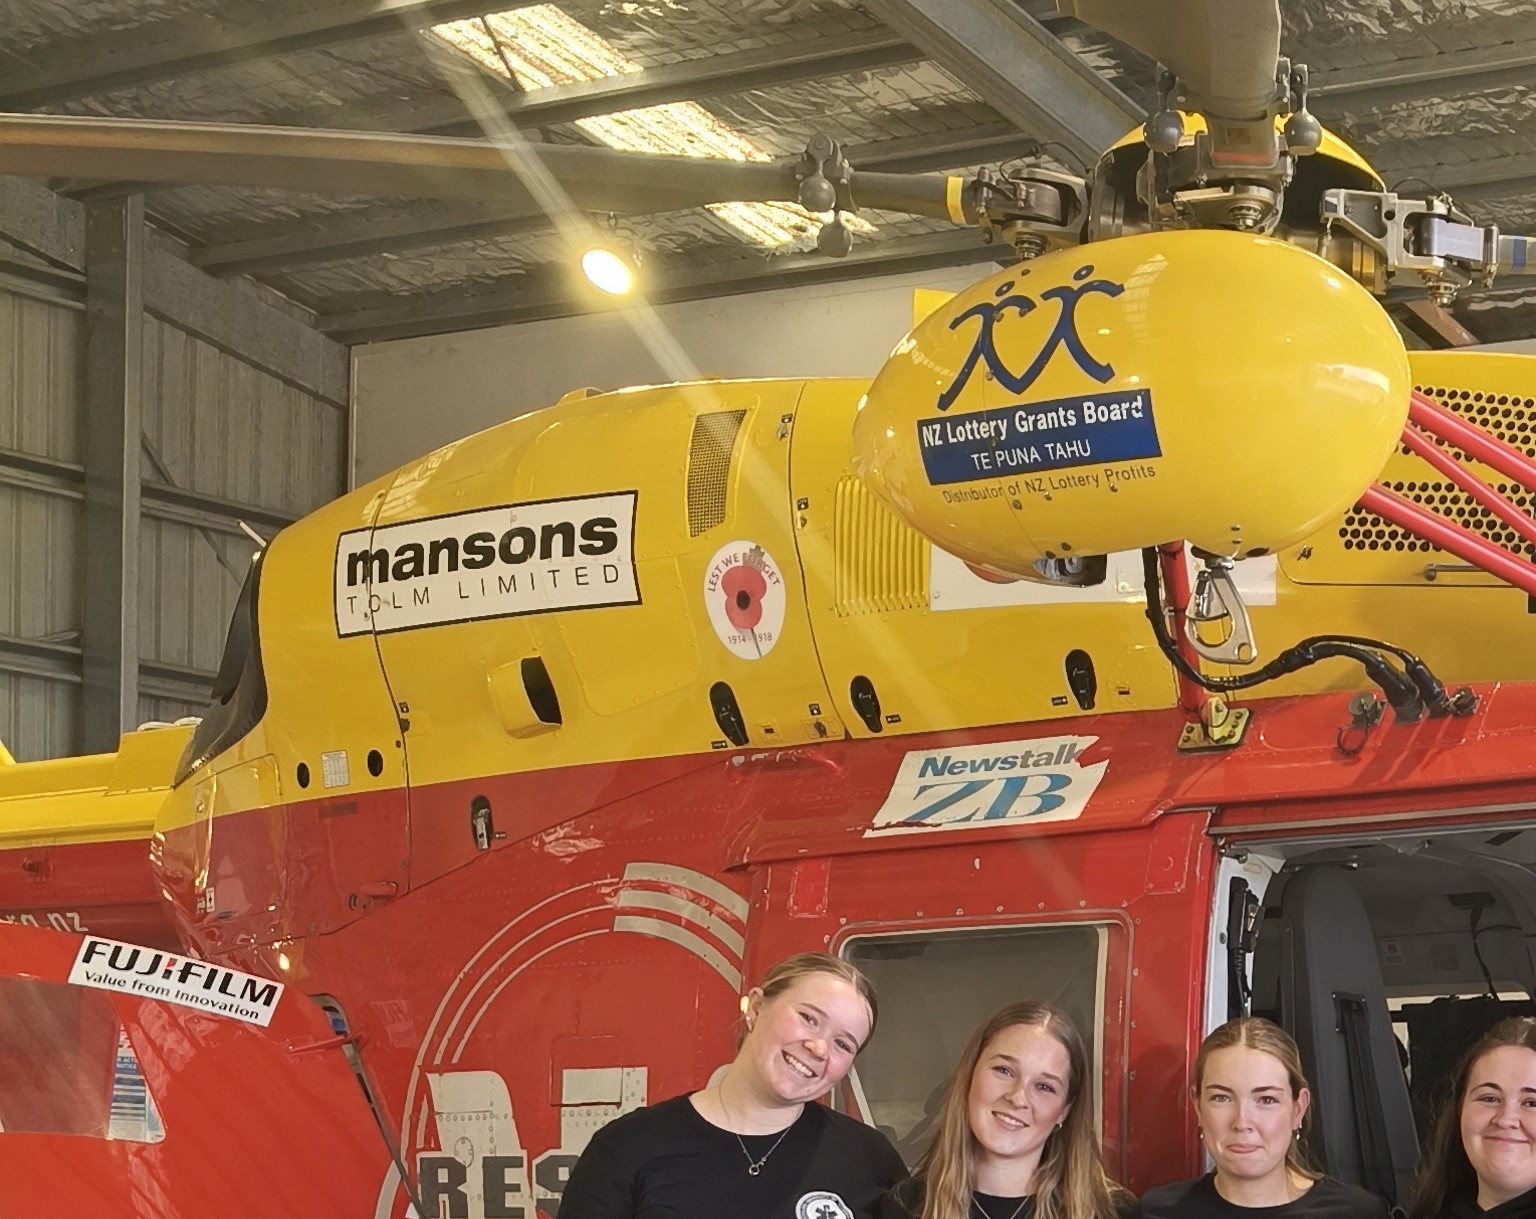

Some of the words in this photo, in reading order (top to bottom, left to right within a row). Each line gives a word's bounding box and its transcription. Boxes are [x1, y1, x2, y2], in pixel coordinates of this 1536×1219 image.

[922, 424, 942, 448] NZ
[946, 415, 1008, 444] Lottery
[1014, 406, 1077, 433] Grants
[1082, 395, 1144, 425] Board
[971, 452, 992, 472] TE
[995, 448, 1041, 468] PUNA
[1045, 439, 1091, 461] TAHU
[942, 486, 1004, 504] Distributor
[1008, 482, 1021, 496] of
[1024, 478, 1046, 494] NZ
[1050, 473, 1100, 491] Lottery
[1104, 464, 1156, 483] Profits
[347, 516, 618, 587] mansons
[459, 564, 619, 600] LIMITED
[707, 564, 723, 592] LEST
[722, 552, 740, 568] WE
[742, 552, 781, 586] FORGET
[727, 633, 747, 645] 1914
[918, 743, 1085, 778] Newstalk
[902, 773, 1073, 823] ZB
[82, 940, 278, 1007] FUJIFILM
[85, 970, 127, 988] Value
[132, 979, 170, 996] from
[174, 989, 260, 1020] Innovation
